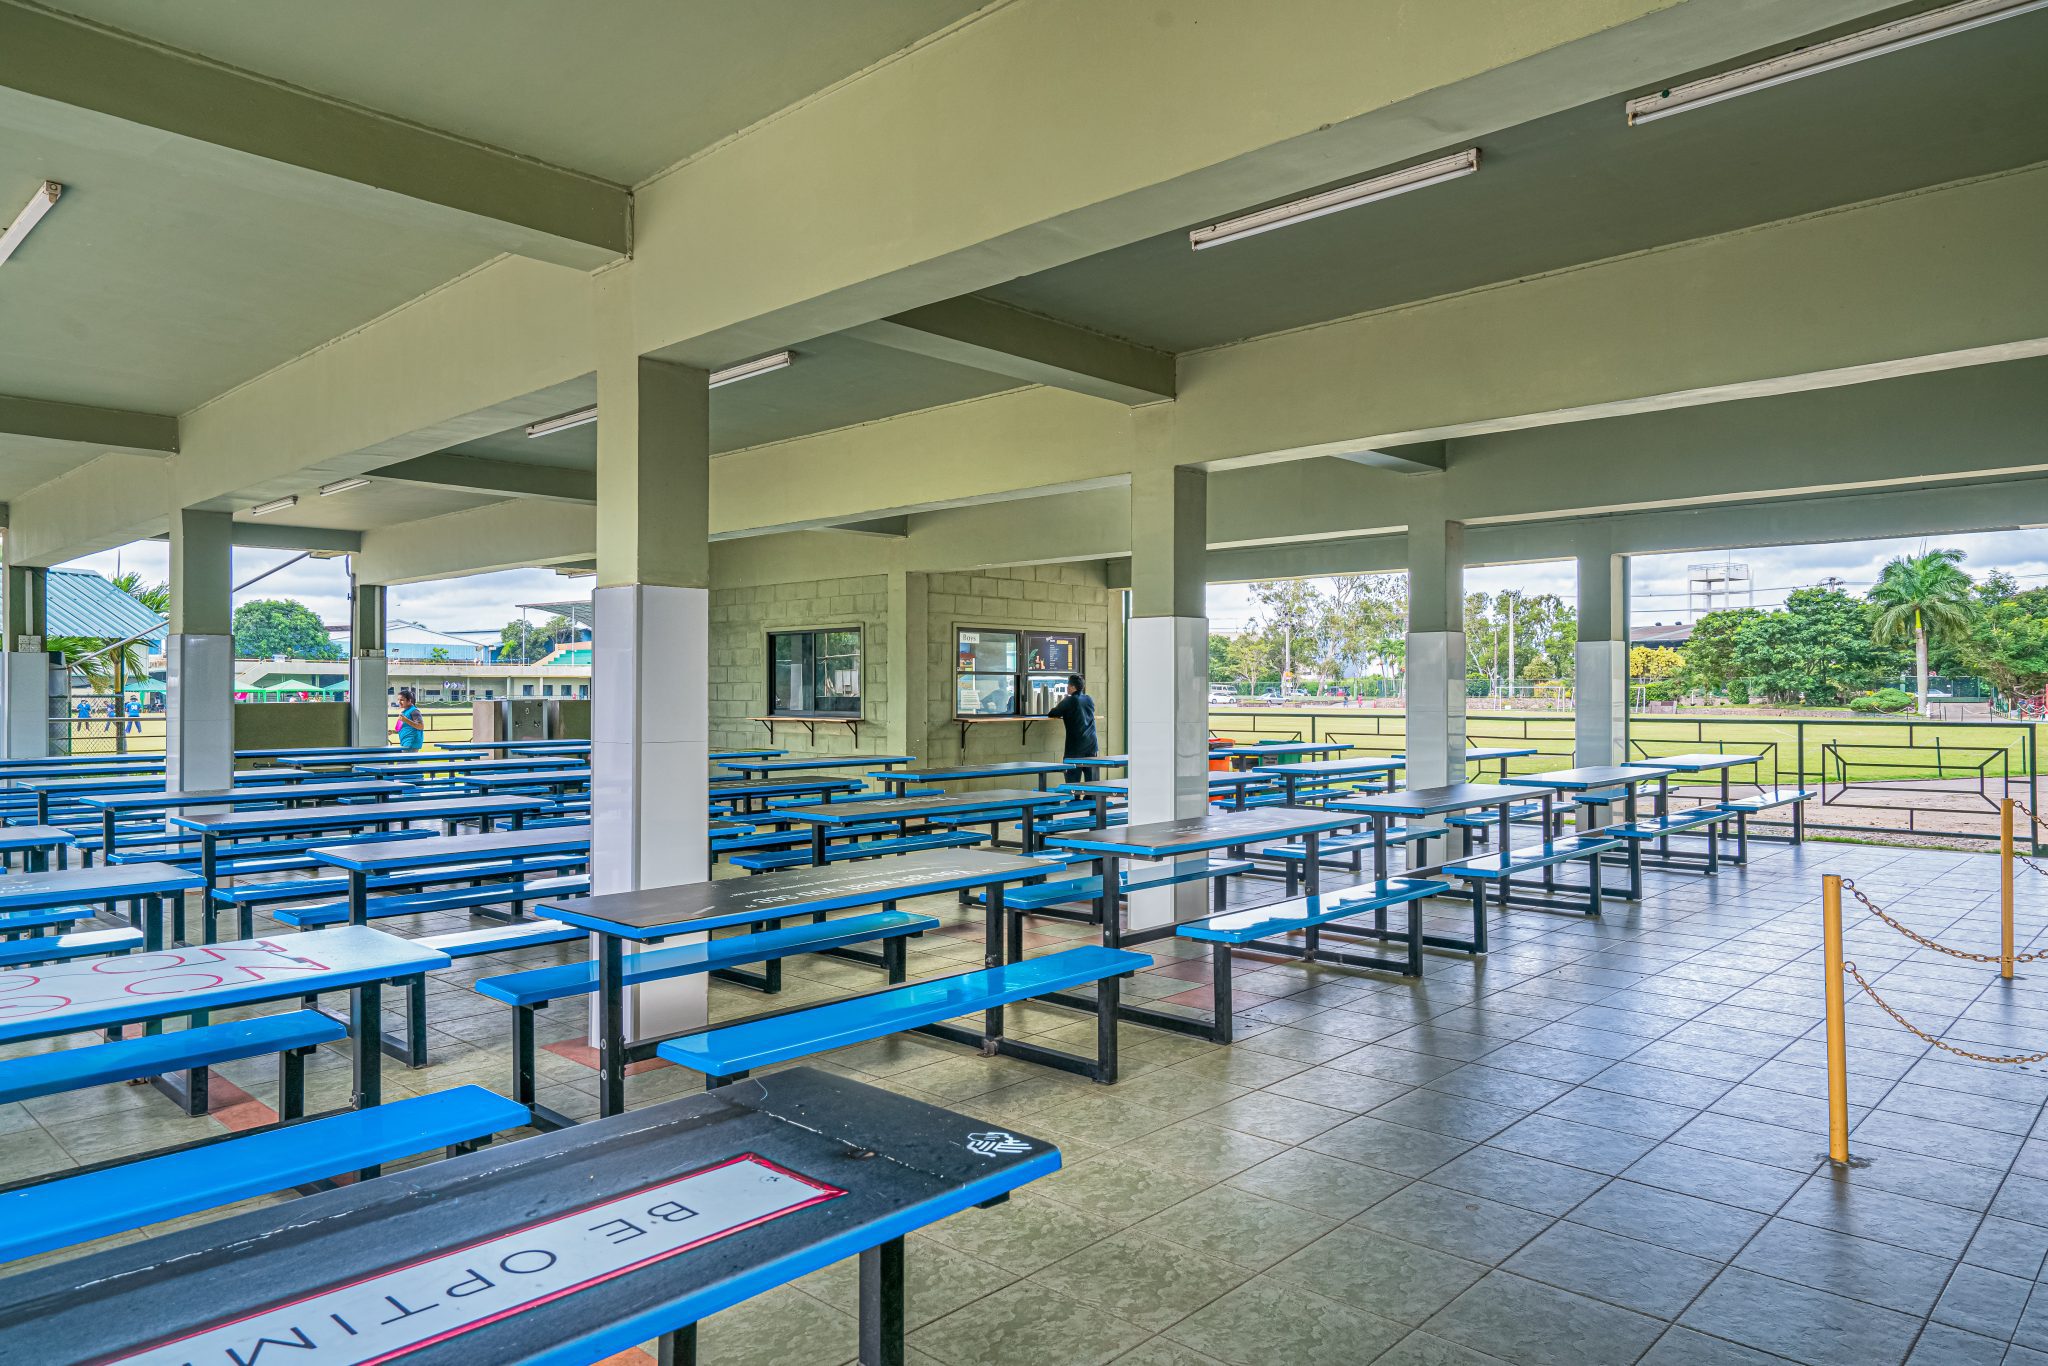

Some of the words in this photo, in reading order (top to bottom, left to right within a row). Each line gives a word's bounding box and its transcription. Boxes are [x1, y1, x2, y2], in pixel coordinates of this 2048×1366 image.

[92, 941, 288, 974] NO
[124, 957, 330, 995] NO
[588, 1200, 700, 1244] BE
[183, 1249, 558, 1366] OPTIM
